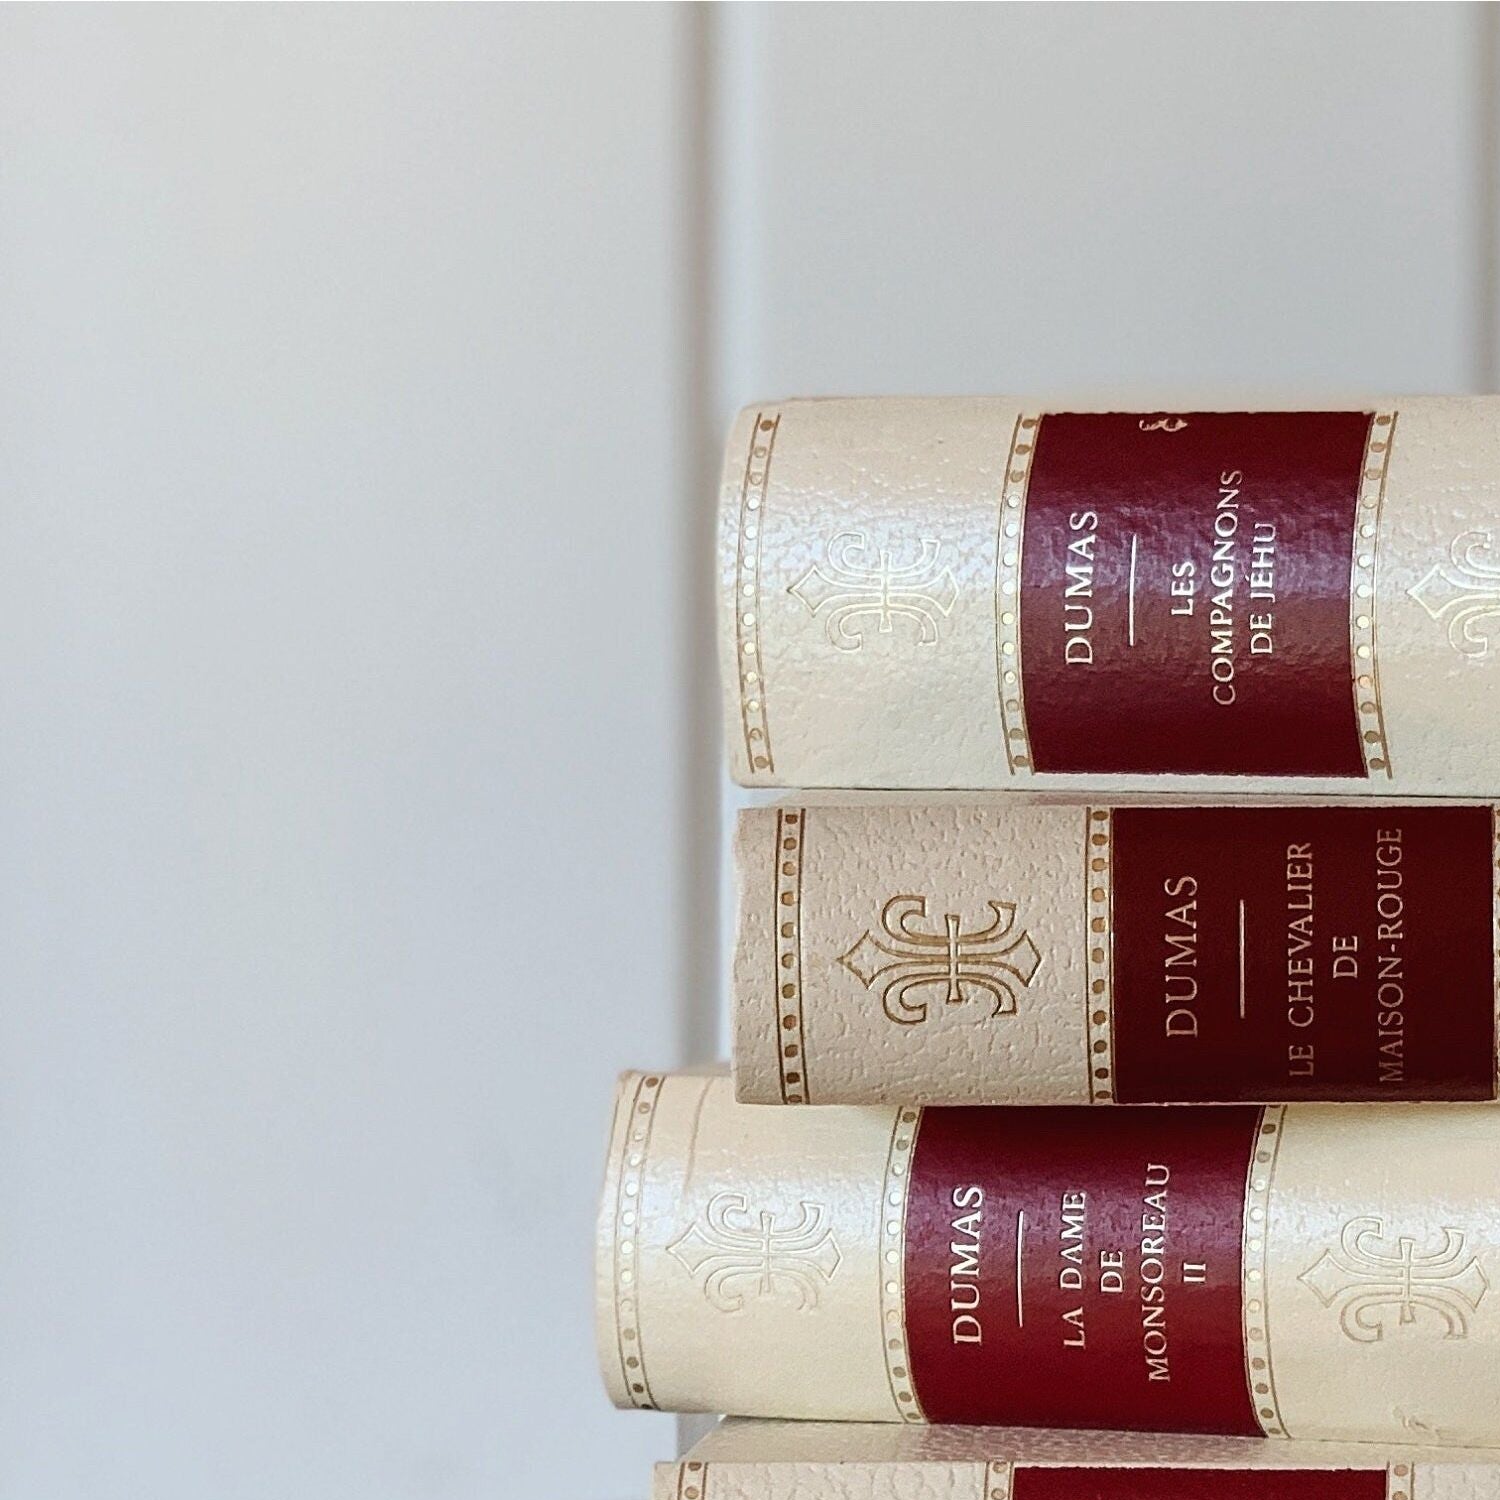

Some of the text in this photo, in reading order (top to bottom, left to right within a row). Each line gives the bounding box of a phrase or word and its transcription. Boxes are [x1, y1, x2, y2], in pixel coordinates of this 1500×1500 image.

[1065, 511, 1098, 665] DUMAS
[1171, 561, 1195, 616] LES
[1210, 469, 1243, 705] COMPAGNONS
[1244, 522, 1277, 655] DE JÉHU
[1165, 876, 1198, 1038] DUMAS
[1287, 842, 1314, 1077] LE CHEVALIER
[1333, 935, 1358, 979] DE
[1376, 828, 1403, 1082] MAISON-ROUGE
[950, 1185, 983, 1346] DUMAS
[1059, 1191, 1087, 1349] LA DAME
[1100, 1250, 1123, 1293] DE
[1140, 1162, 1170, 1382] MONSOREAU
[1183, 1262, 1206, 1284] II
